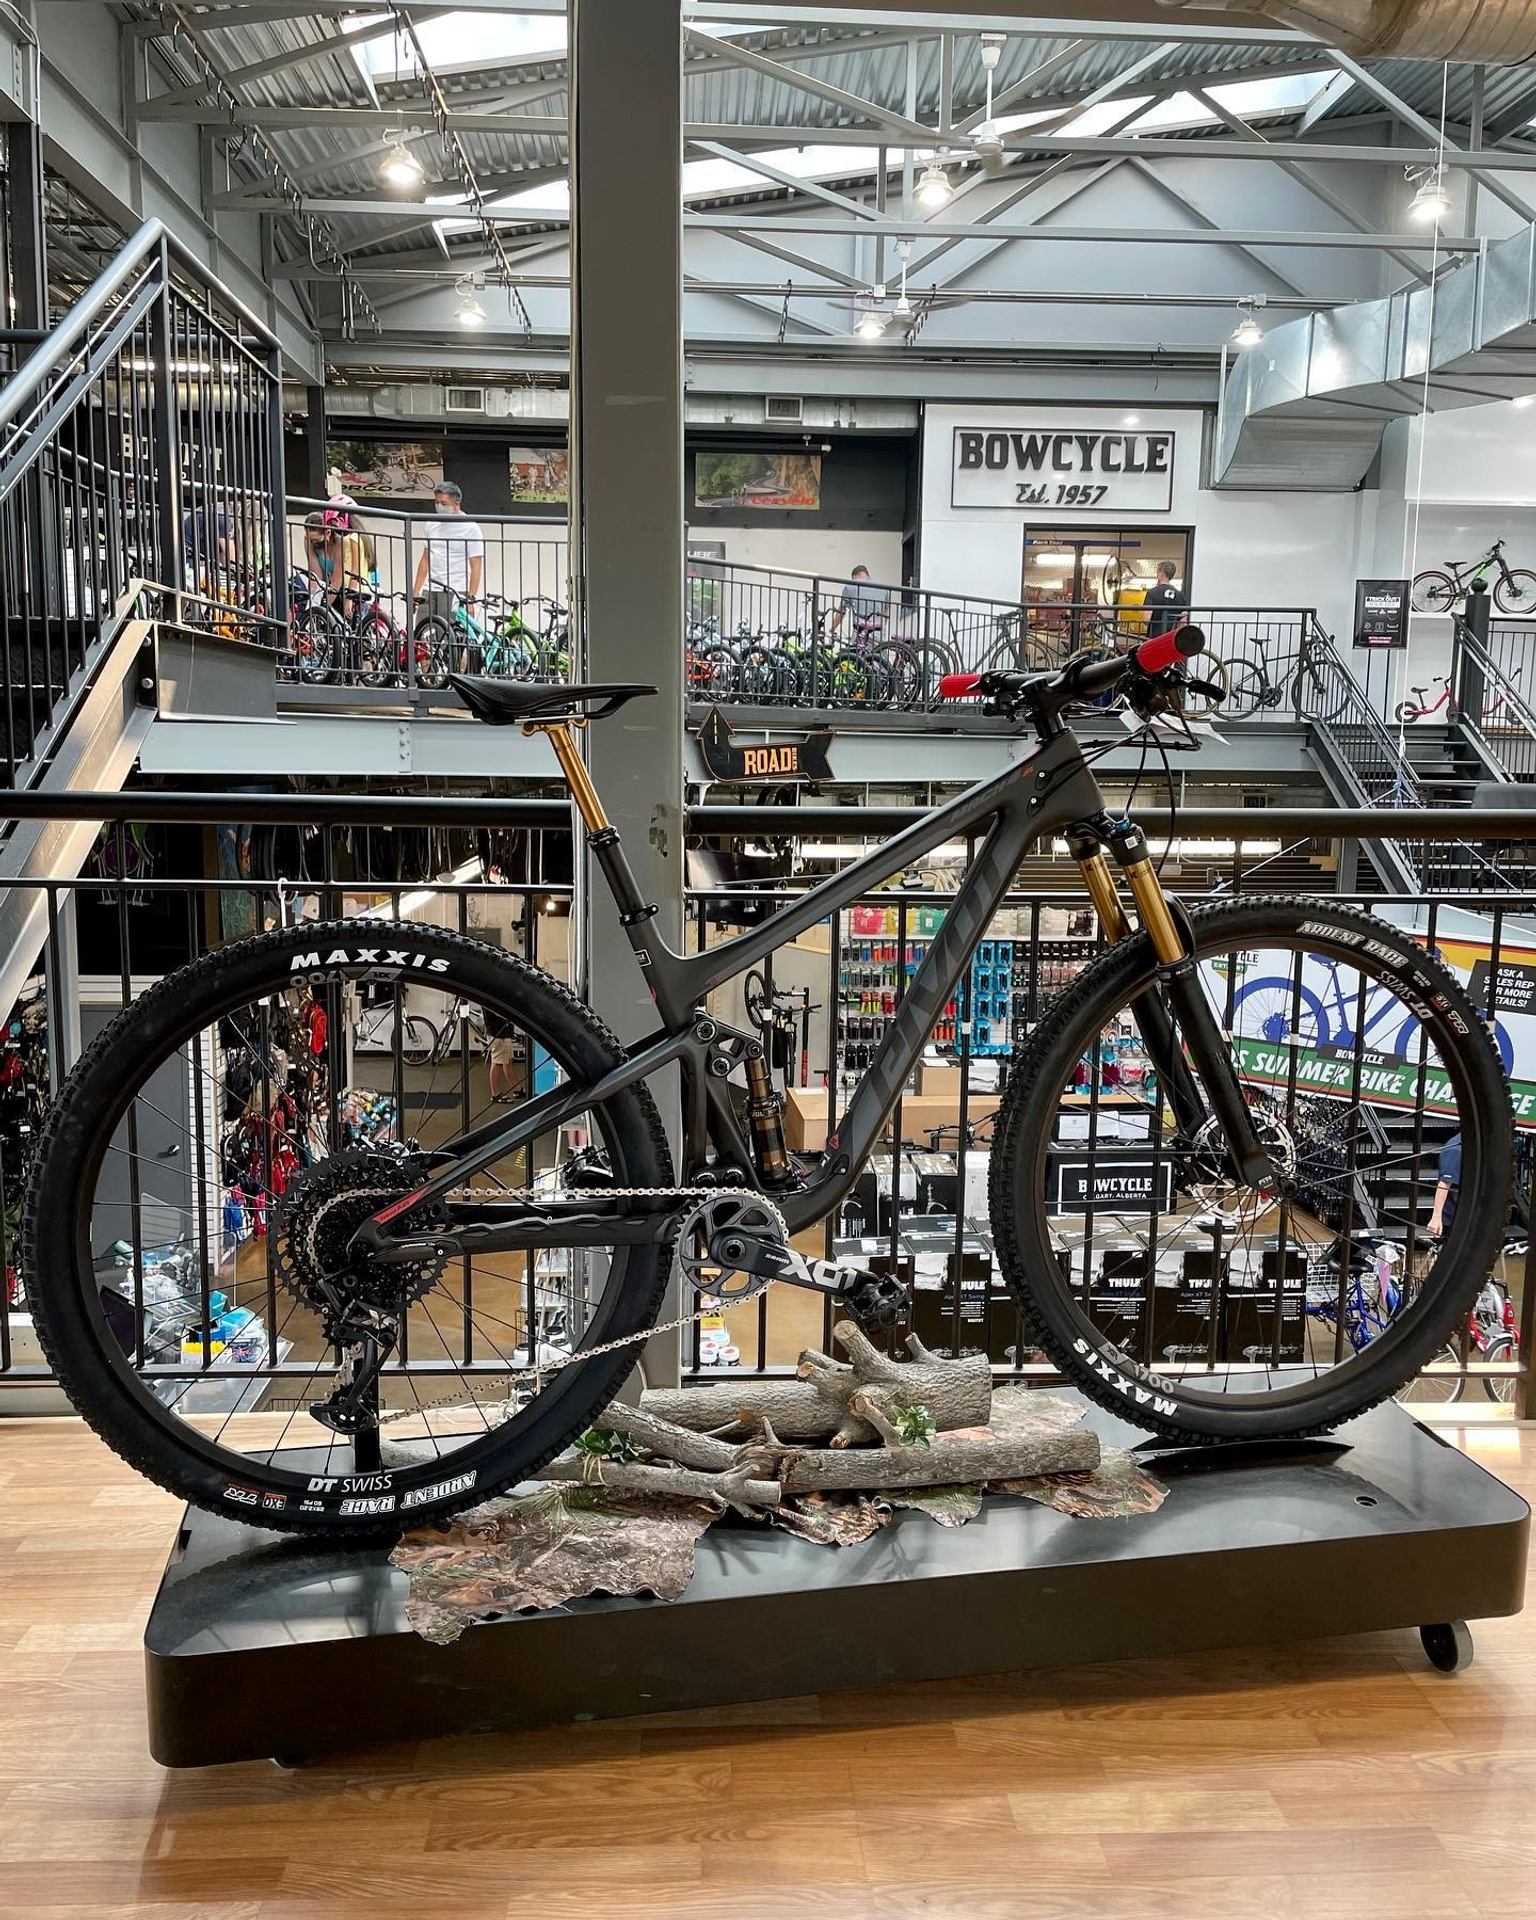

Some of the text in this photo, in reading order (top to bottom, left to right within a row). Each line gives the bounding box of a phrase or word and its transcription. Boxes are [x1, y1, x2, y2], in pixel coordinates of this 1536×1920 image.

[958, 432, 1170, 473] BOWCYCLE
[1015, 483, 1109, 506] Est. 1957
[687, 550, 717, 558] UBE
[744, 747, 792, 775] ROAD
[1297, 920, 1409, 968] ARDENT RACE
[290, 949, 451, 972] MAXXIS
[1376, 969, 1416, 1001] SWISS
[1483, 976, 1535, 990] SLES REP
[1482, 985, 1534, 999] FR MORE
[1485, 995, 1528, 1008] ETAILS!
[1409, 1001, 1434, 1020] DT
[1335, 1049, 1386, 1065] BOWYCLE
[1358, 1068, 1406, 1094] BIKE
[1078, 1177, 1153, 1193] BWCYCLE
[1082, 1192, 1115, 1200] CGARY,
[952, 1280, 987, 1291] HULE
[1108, 1278, 1142, 1288] THULE
[1268, 1278, 1302, 1289] TULE
[1073, 1337, 1179, 1417] MAXXIS
[307, 1474, 393, 1493] DT SWISS
[339, 1470, 477, 1515] ARDENT RACE
[262, 1497, 286, 1511] EXO
